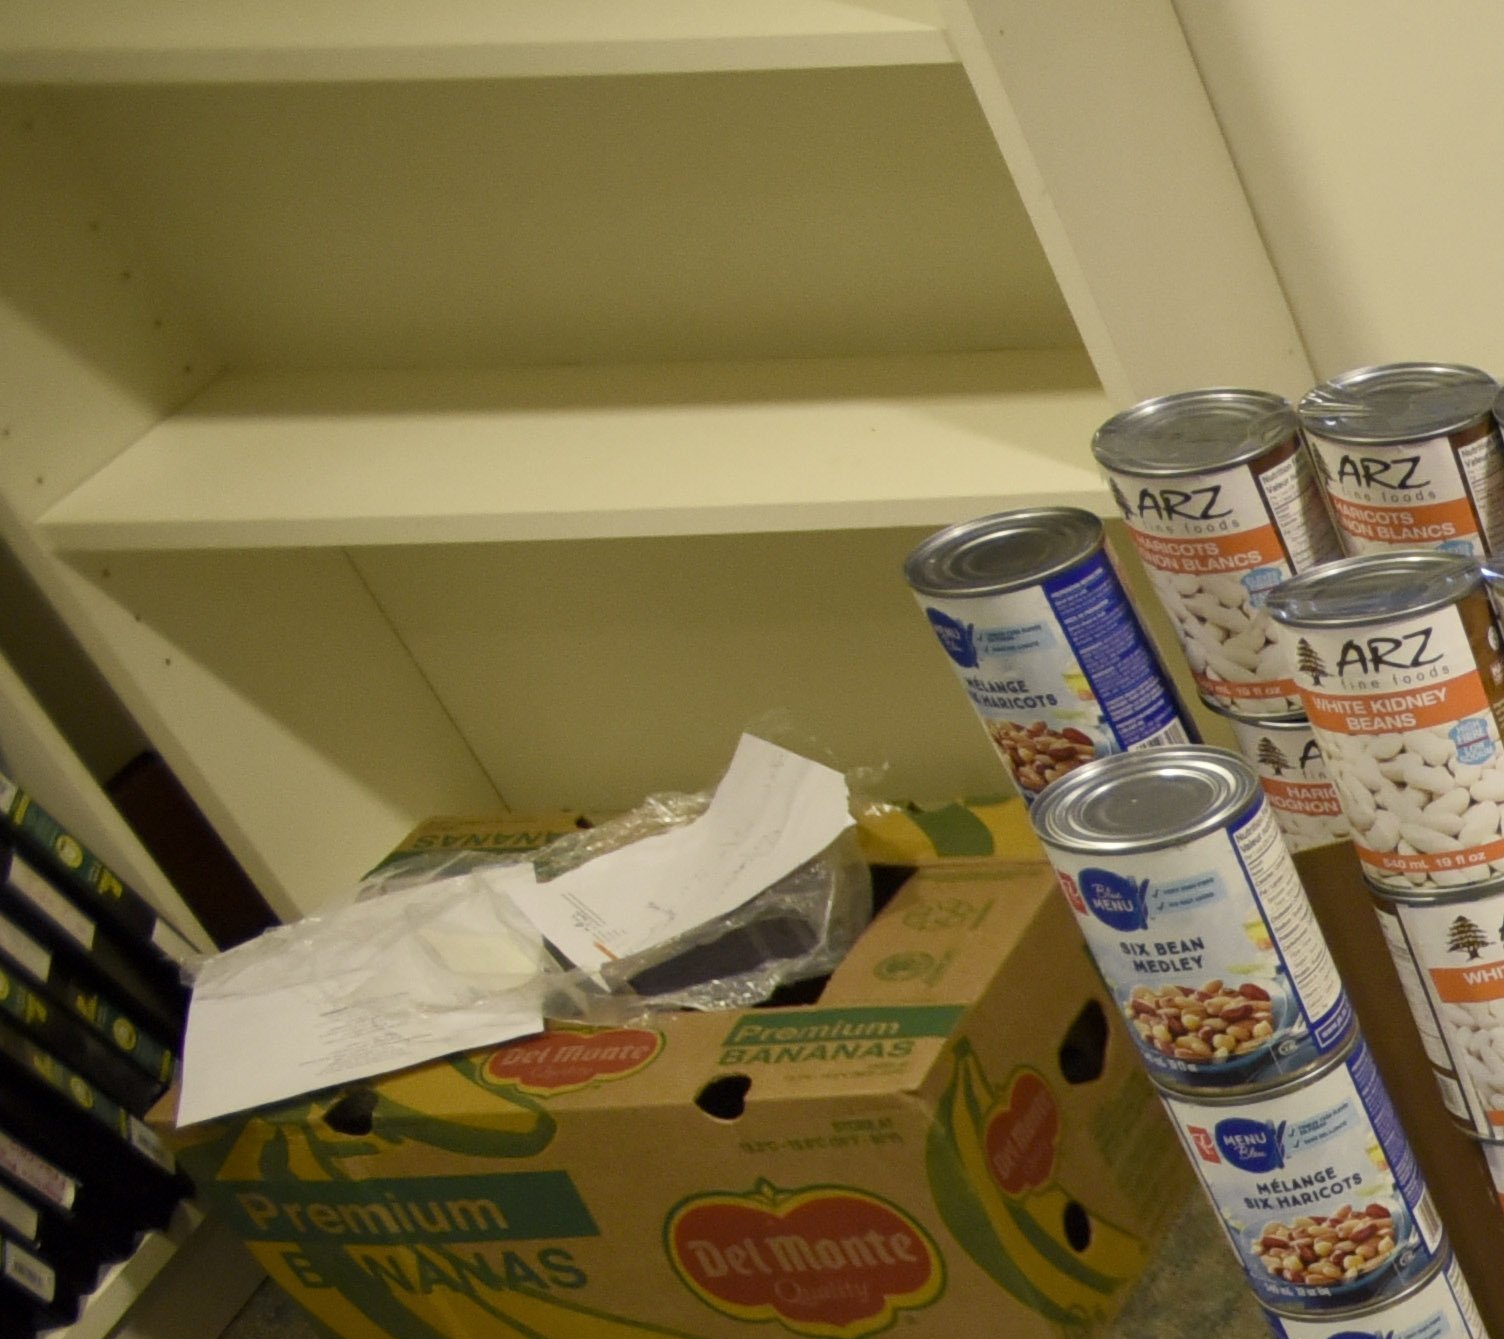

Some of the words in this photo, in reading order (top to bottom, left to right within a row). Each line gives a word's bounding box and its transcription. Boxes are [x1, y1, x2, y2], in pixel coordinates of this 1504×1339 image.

[1338, 454, 1431, 490] ARZ
[1138, 485, 1233, 521] ARZ
[1377, 522, 1455, 537] BLANCS
[1337, 628, 1443, 677] ARZ
[1313, 697, 1366, 716] WHITE
[1372, 687, 1447, 712] KIDNEY
[1346, 712, 1416, 730] BEANS
[1435, 856, 1451, 868] 19
[1093, 899, 1134, 914] MENU
[1120, 941, 1149, 956] SIX
[1155, 938, 1205, 956] BEAN
[1133, 957, 1203, 973] MEDLEY
[735, 1020, 898, 1043] Premium
[501, 1047, 546, 1066] Del
[553, 1042, 652, 1063] Monte
[718, 1039, 916, 1065] BANANAS
[1223, 1132, 1267, 1149] MENU
[1245, 1196, 1273, 1210] SIX
[1279, 1173, 1362, 1208] HARICOTS
[1256, 1167, 1336, 1196] MÉLANGE
[239, 1191, 508, 1234] Premium
[688, 1238, 770, 1280] Del
[775, 1230, 916, 1272] Monte
[292, 1247, 586, 1291] BNANAS
